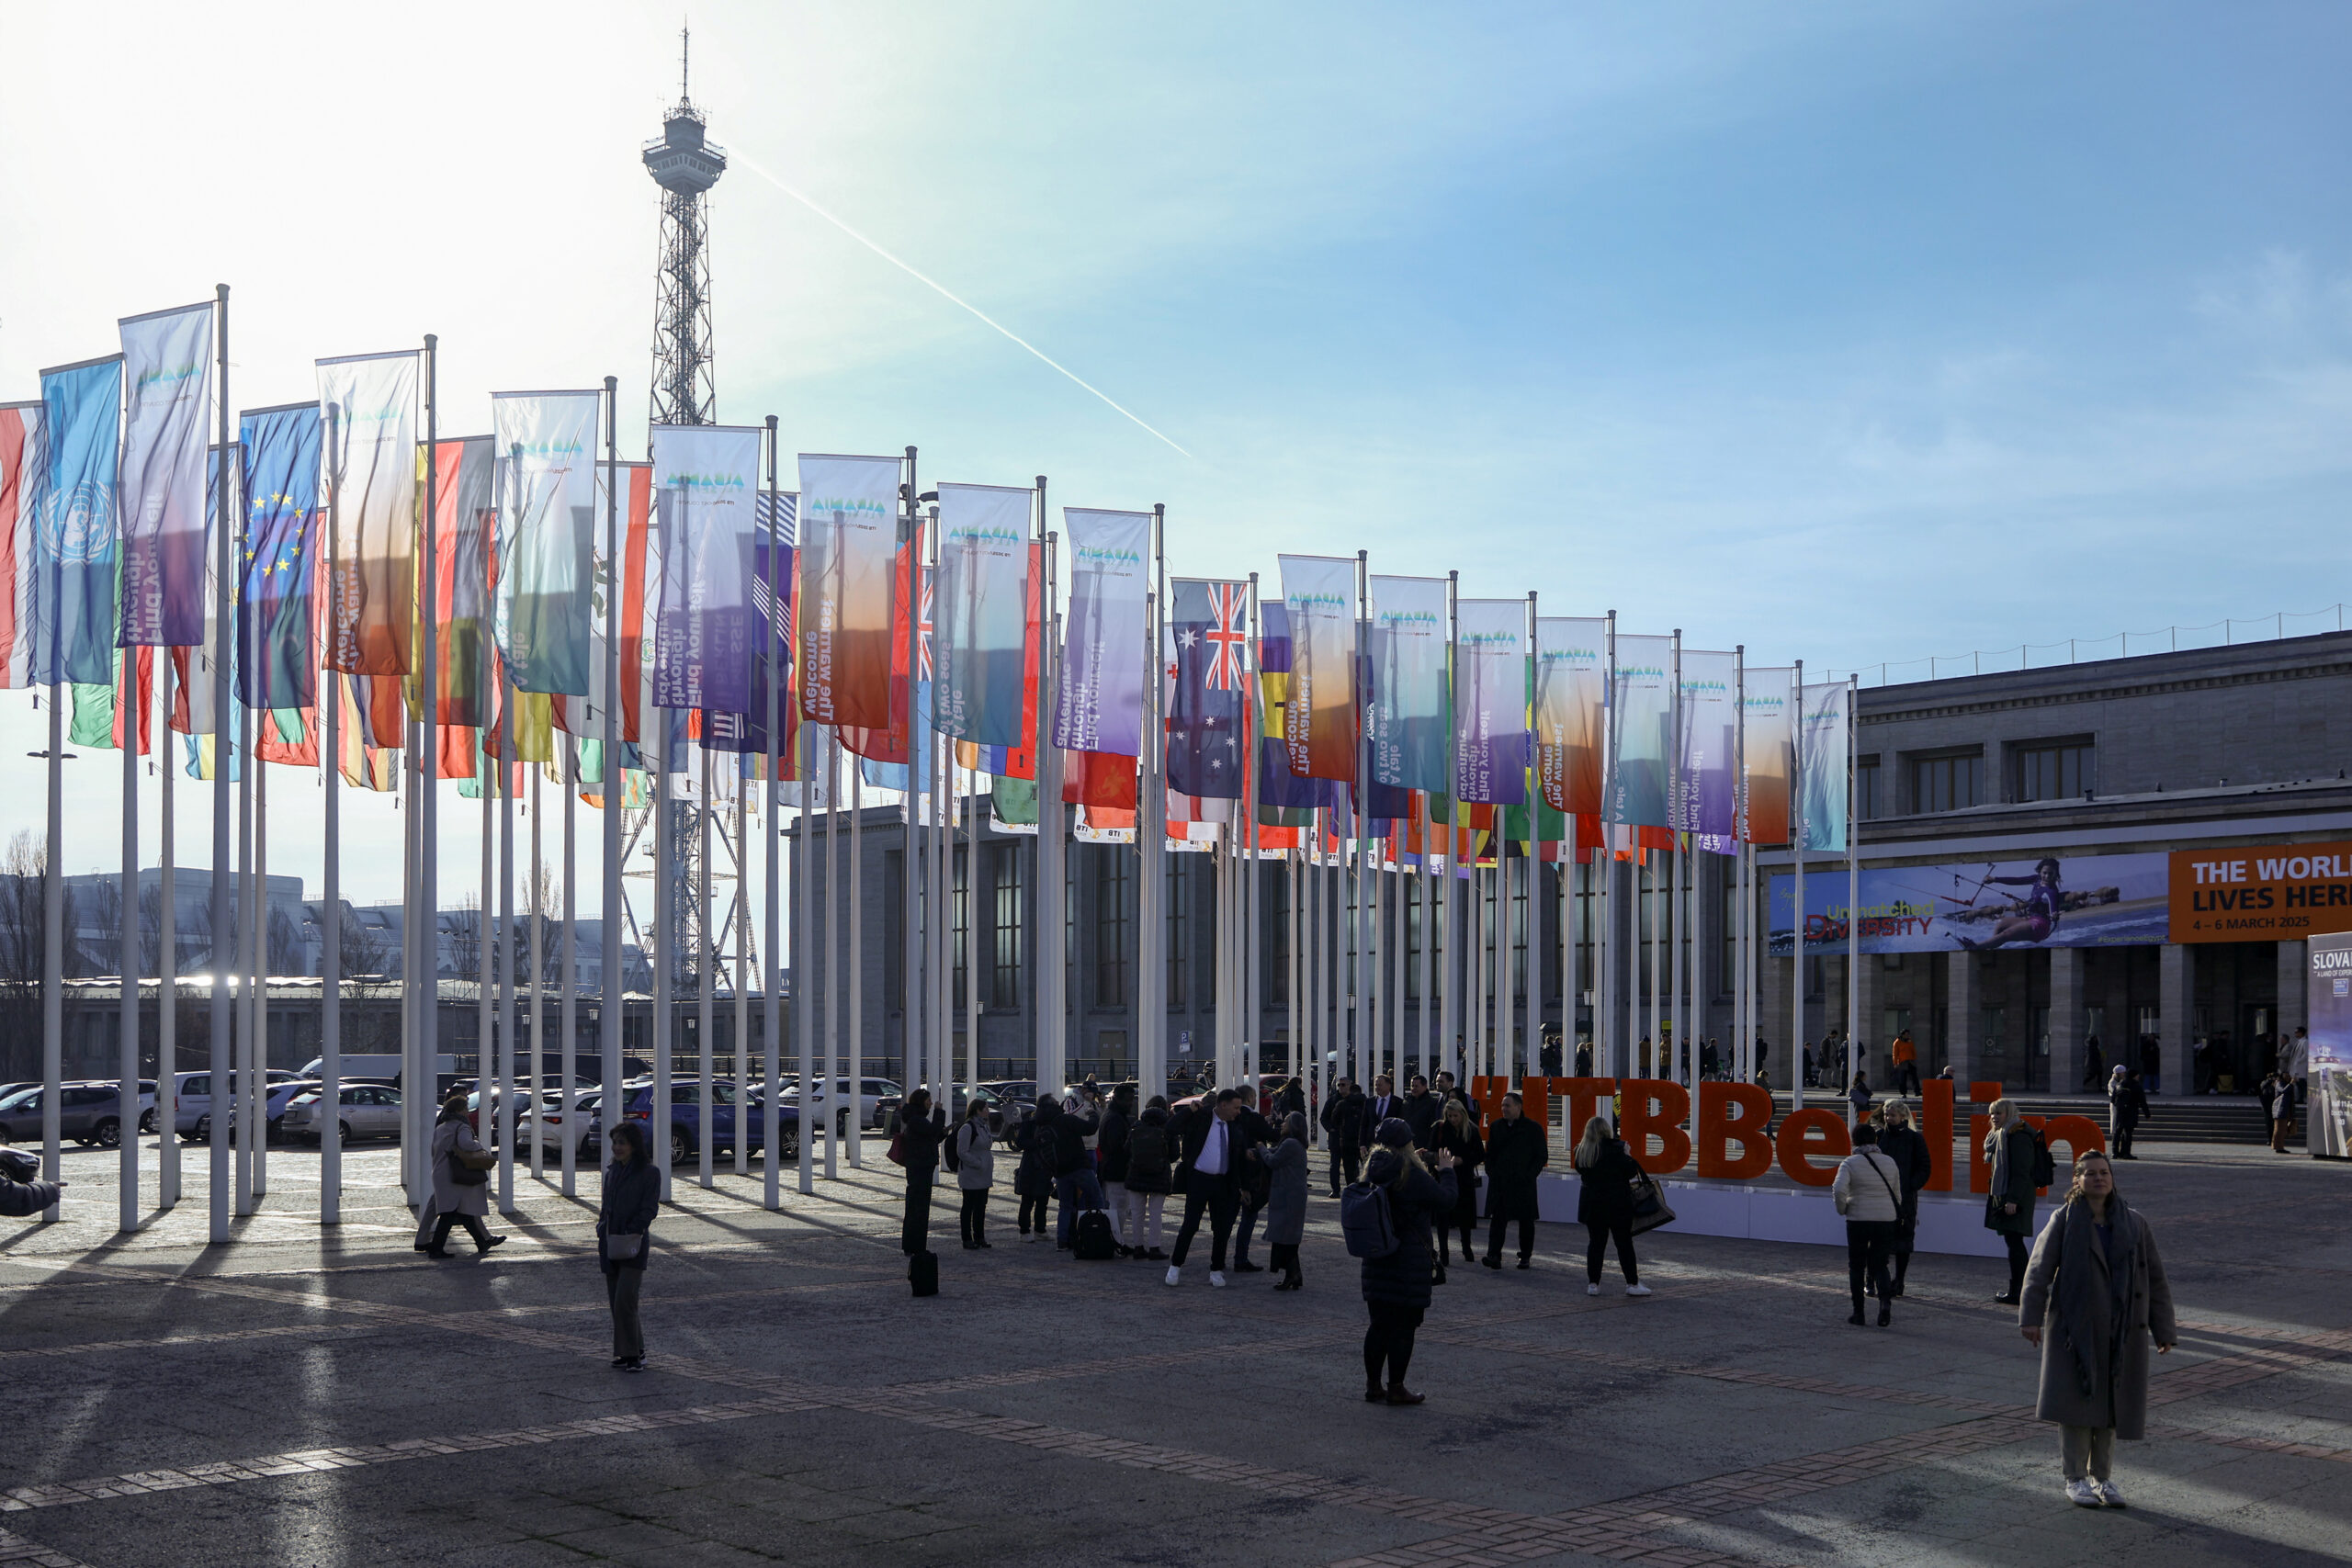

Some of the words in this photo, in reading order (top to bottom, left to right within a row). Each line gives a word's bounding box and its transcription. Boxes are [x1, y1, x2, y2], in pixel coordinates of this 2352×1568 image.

[2191, 860, 2247, 884] THE
[2256, 854, 2352, 881] WORL
[2193, 887, 2274, 911] LIVES
[2193, 920, 2201, 931] 4
[2215, 919, 2222, 930] 6
[2226, 918, 2275, 931] MARCH
[2278, 916, 2310, 928] 2025
[2312, 951, 2352, 970] SLOVA
